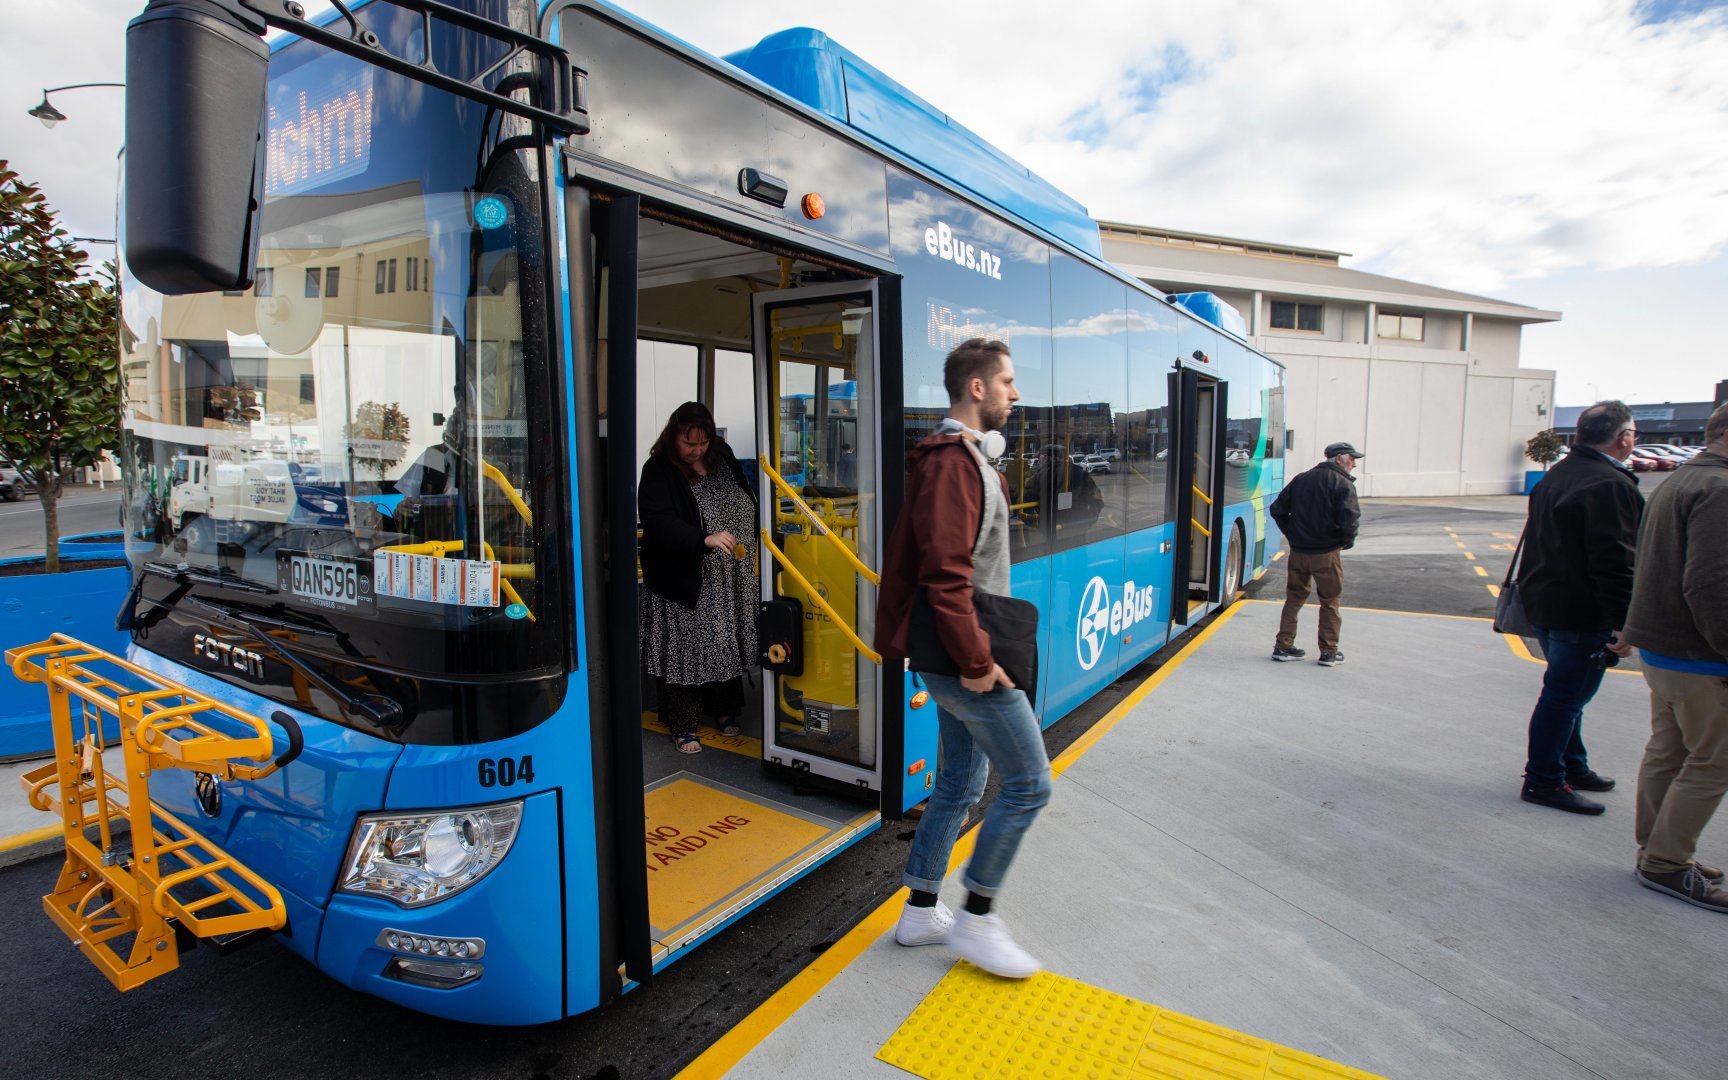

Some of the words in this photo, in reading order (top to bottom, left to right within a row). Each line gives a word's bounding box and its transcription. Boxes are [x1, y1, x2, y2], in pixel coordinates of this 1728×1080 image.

[264, 88, 373, 192] ichm
[924, 221, 1002, 281] eBus.nz
[292, 561, 356, 600] QAN596
[1110, 580, 1153, 636] eBus
[193, 633, 264, 678] FOTON
[478, 754, 535, 788] 604
[646, 815, 752, 872] ANDING
